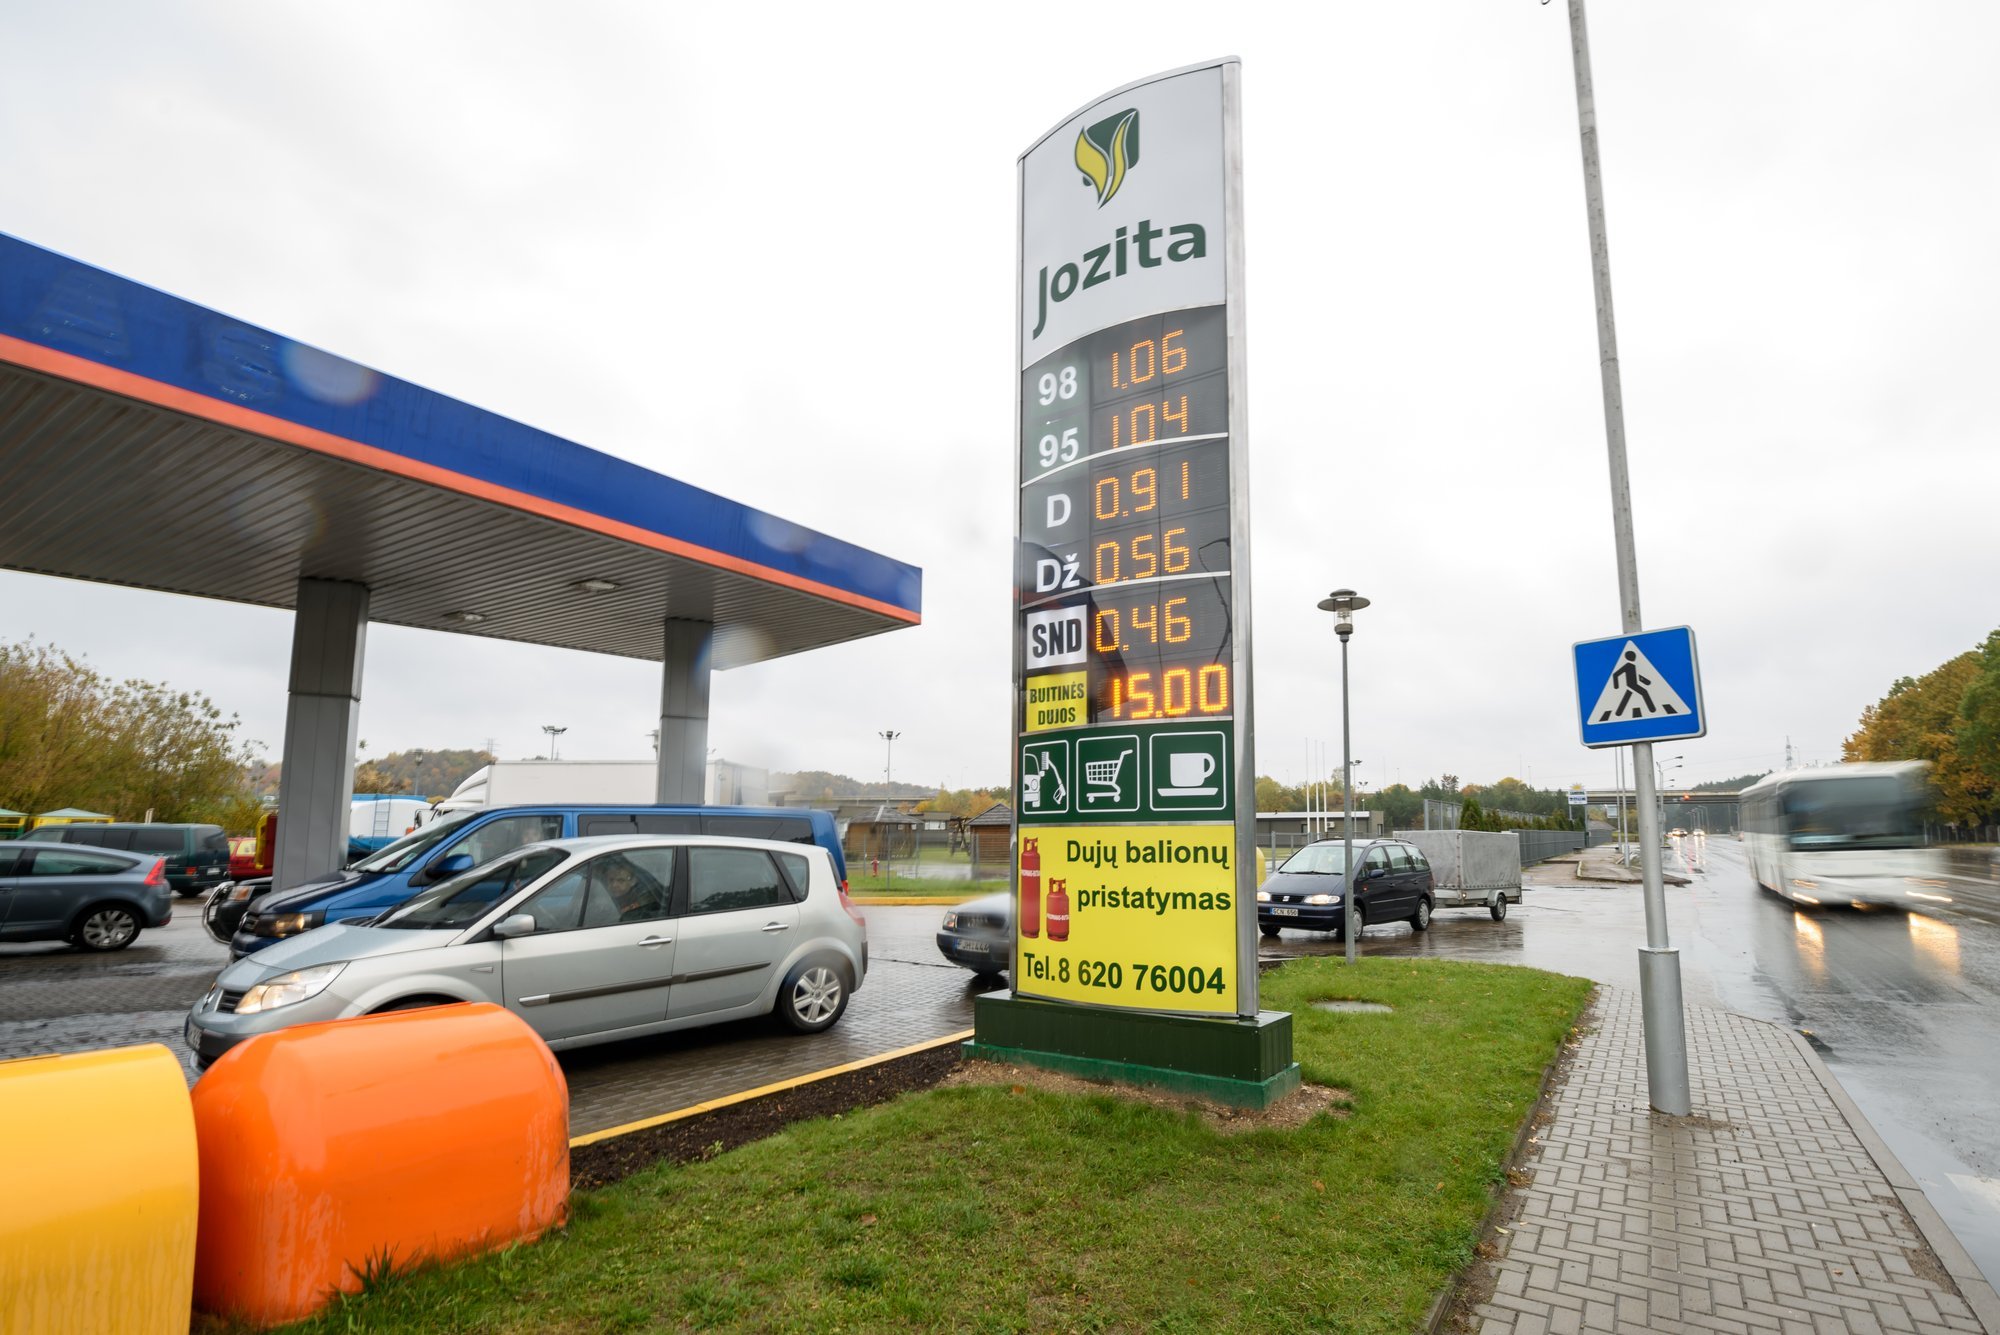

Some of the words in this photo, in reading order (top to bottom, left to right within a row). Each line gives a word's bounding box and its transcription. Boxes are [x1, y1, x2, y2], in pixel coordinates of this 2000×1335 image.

[1033, 219, 1206, 340] Jozita
[1112, 329, 1187, 389] 1.06
[1038, 366, 1078, 406] 98
[1038, 427, 1080, 468] 95
[1046, 493, 1072, 528] D
[1036, 553, 1080, 593] Dž
[1095, 527, 1190, 585] 0.56
[1032, 618, 1082, 659] SND
[1095, 597, 1191, 652] 0.46
[1030, 681, 1084, 704] BUITINĖS
[1112, 664, 1228, 719] 15.00
[1038, 707, 1076, 726] DUJOS
[1067, 840, 1118, 868] Dujų
[1126, 840, 1230, 869] balionų
[1077, 885, 1232, 915] pristatymas
[1078, 960, 1122, 989] 620
[1132, 964, 1226, 995] 76004
